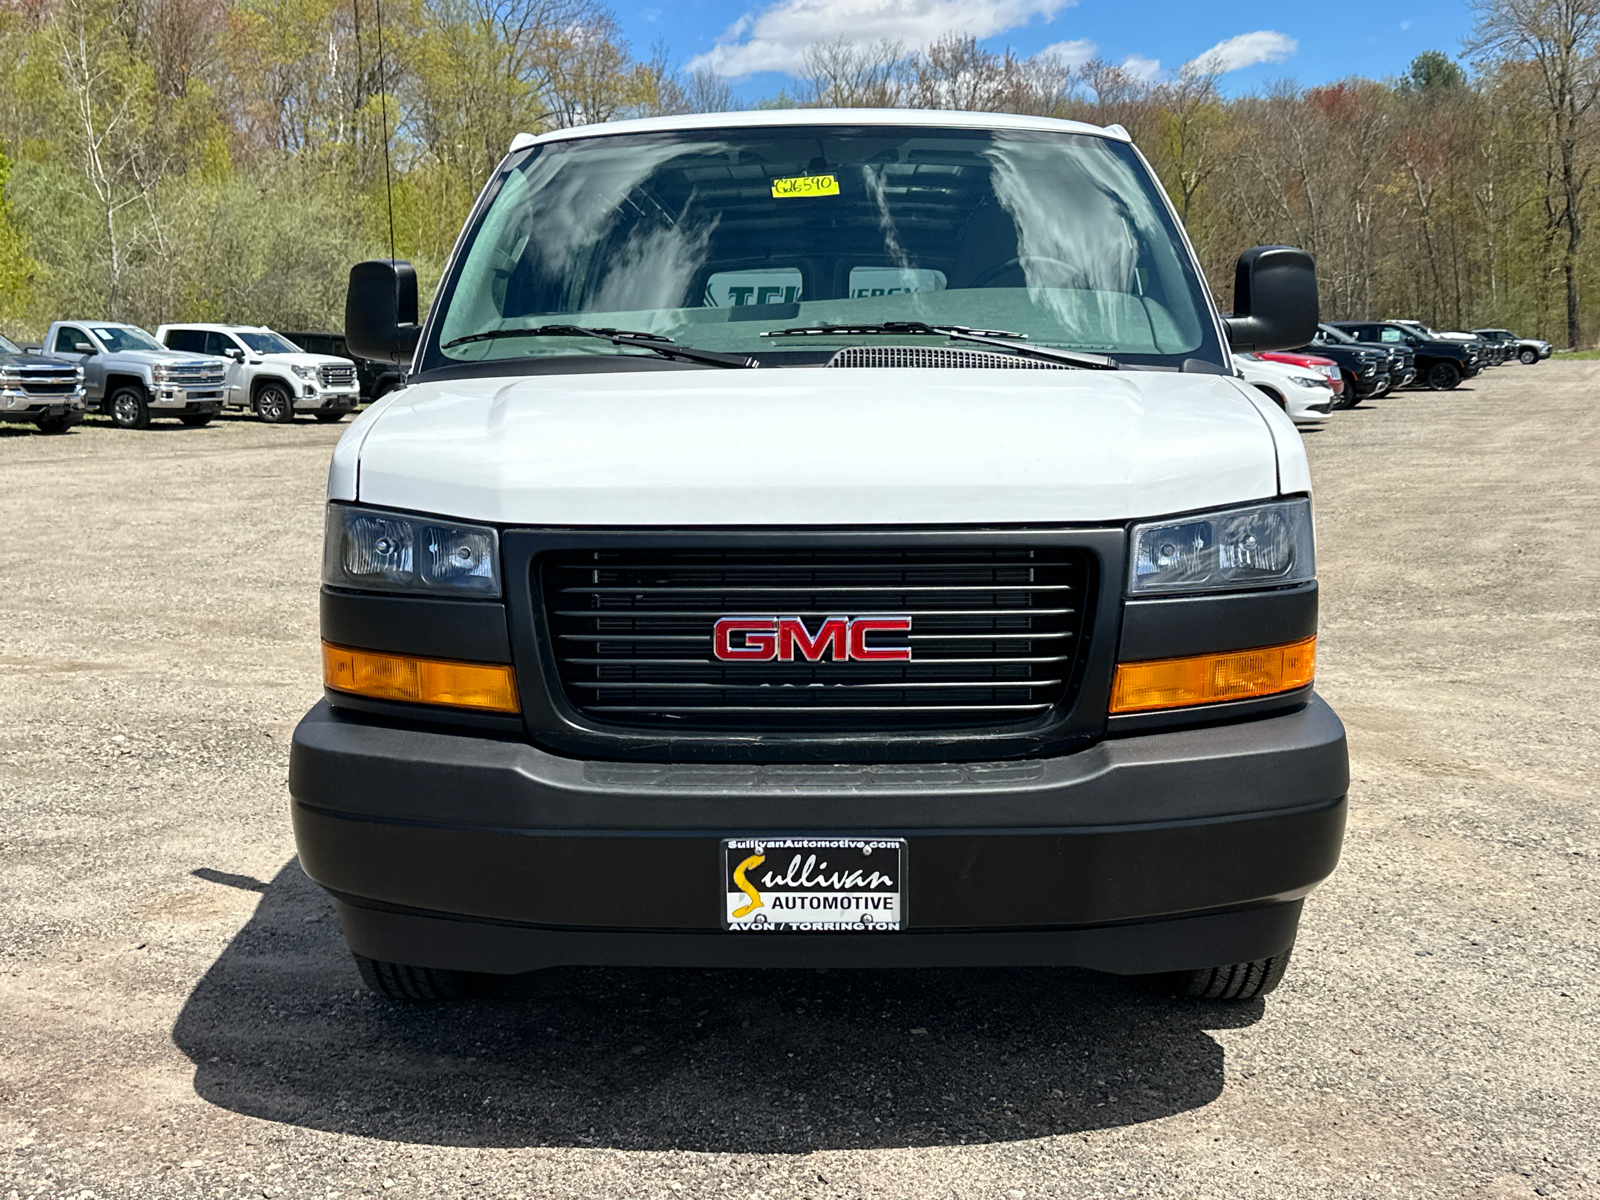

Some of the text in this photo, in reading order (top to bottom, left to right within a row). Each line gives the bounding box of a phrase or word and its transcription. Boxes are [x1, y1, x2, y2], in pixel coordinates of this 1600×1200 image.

[713, 616, 912, 662] GMC
[728, 840, 900, 849] SullivanAutomotive.com
[732, 854, 894, 918] Sullivan
[771, 896, 894, 910] AUTOMOTIVE
[728, 922, 776, 931] AVON
[789, 922, 900, 931] TORRINGTON
